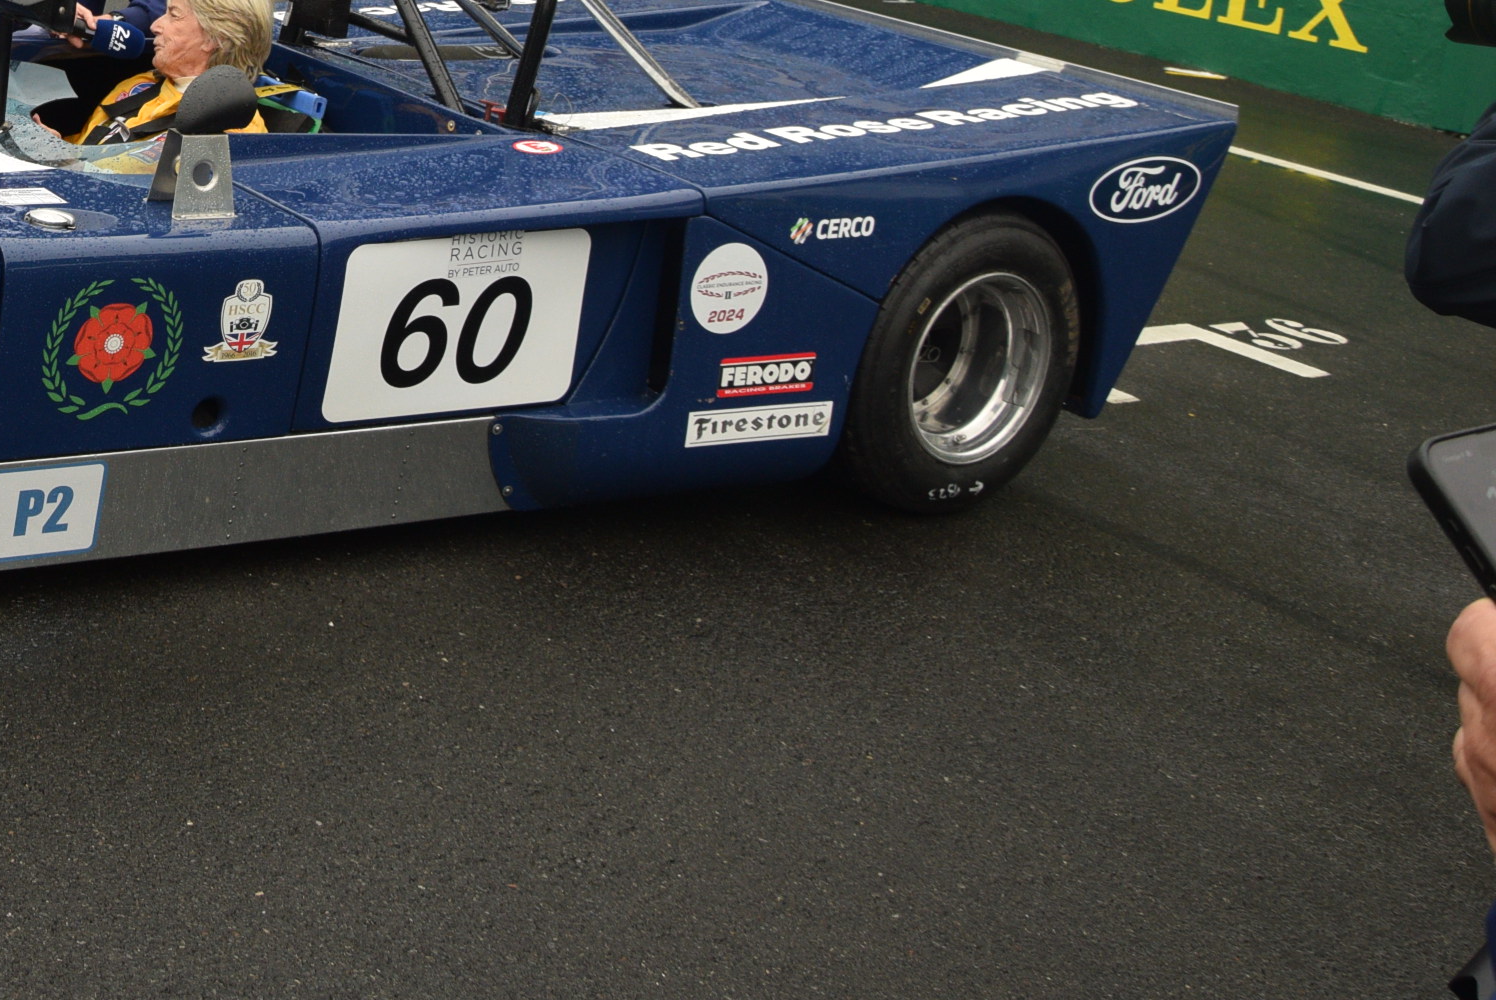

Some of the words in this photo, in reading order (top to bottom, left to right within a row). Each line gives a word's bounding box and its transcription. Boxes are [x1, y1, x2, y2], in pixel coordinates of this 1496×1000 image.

[113, 25, 131, 52] 24h
[630, 130, 781, 161] Red
[764, 117, 931, 145] Rose
[919, 91, 1139, 127] Racing
[1111, 164, 1180, 213] Ford
[816, 215, 875, 240] CERCO
[449, 241, 523, 262] RACING
[447, 269, 460, 278] BY
[462, 264, 492, 277] PETER
[494, 262, 520, 274] AUTO
[243, 282, 257, 294] 50
[228, 303, 266, 316] HSCC
[707, 308, 745, 323] 2024
[380, 275, 533, 388] 60
[1209, 318, 1350, 350] 56
[243, 350, 257, 358] 2016
[720, 360, 812, 388] FERODO
[724, 386, 766, 395] RACING
[768, 383, 807, 391] BRAKES
[694, 410, 827, 440] Firestone
[13, 485, 74, 537] P2
